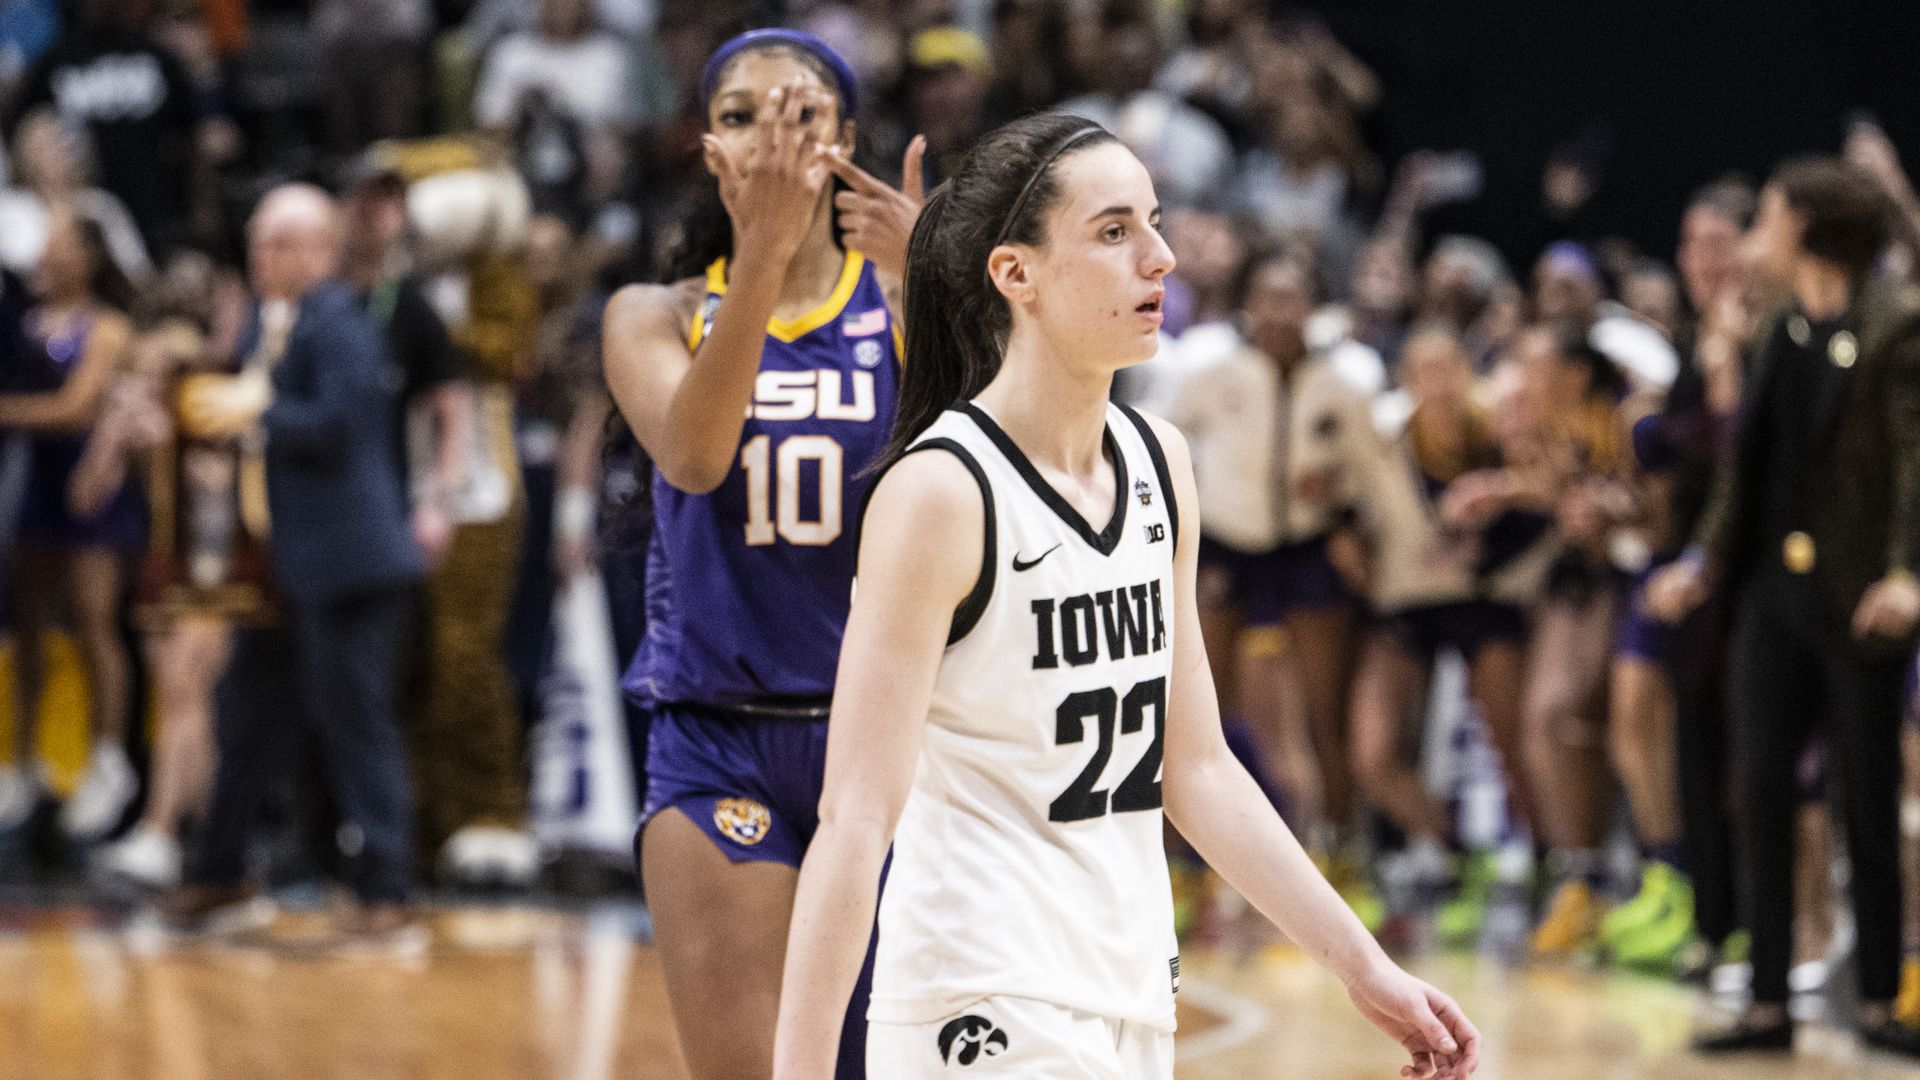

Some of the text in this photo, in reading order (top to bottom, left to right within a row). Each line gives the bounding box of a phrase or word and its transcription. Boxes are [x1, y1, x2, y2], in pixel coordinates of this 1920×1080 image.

[745, 369, 876, 421] SU
[741, 434, 844, 546] 10
[1048, 675, 1166, 822] 22
